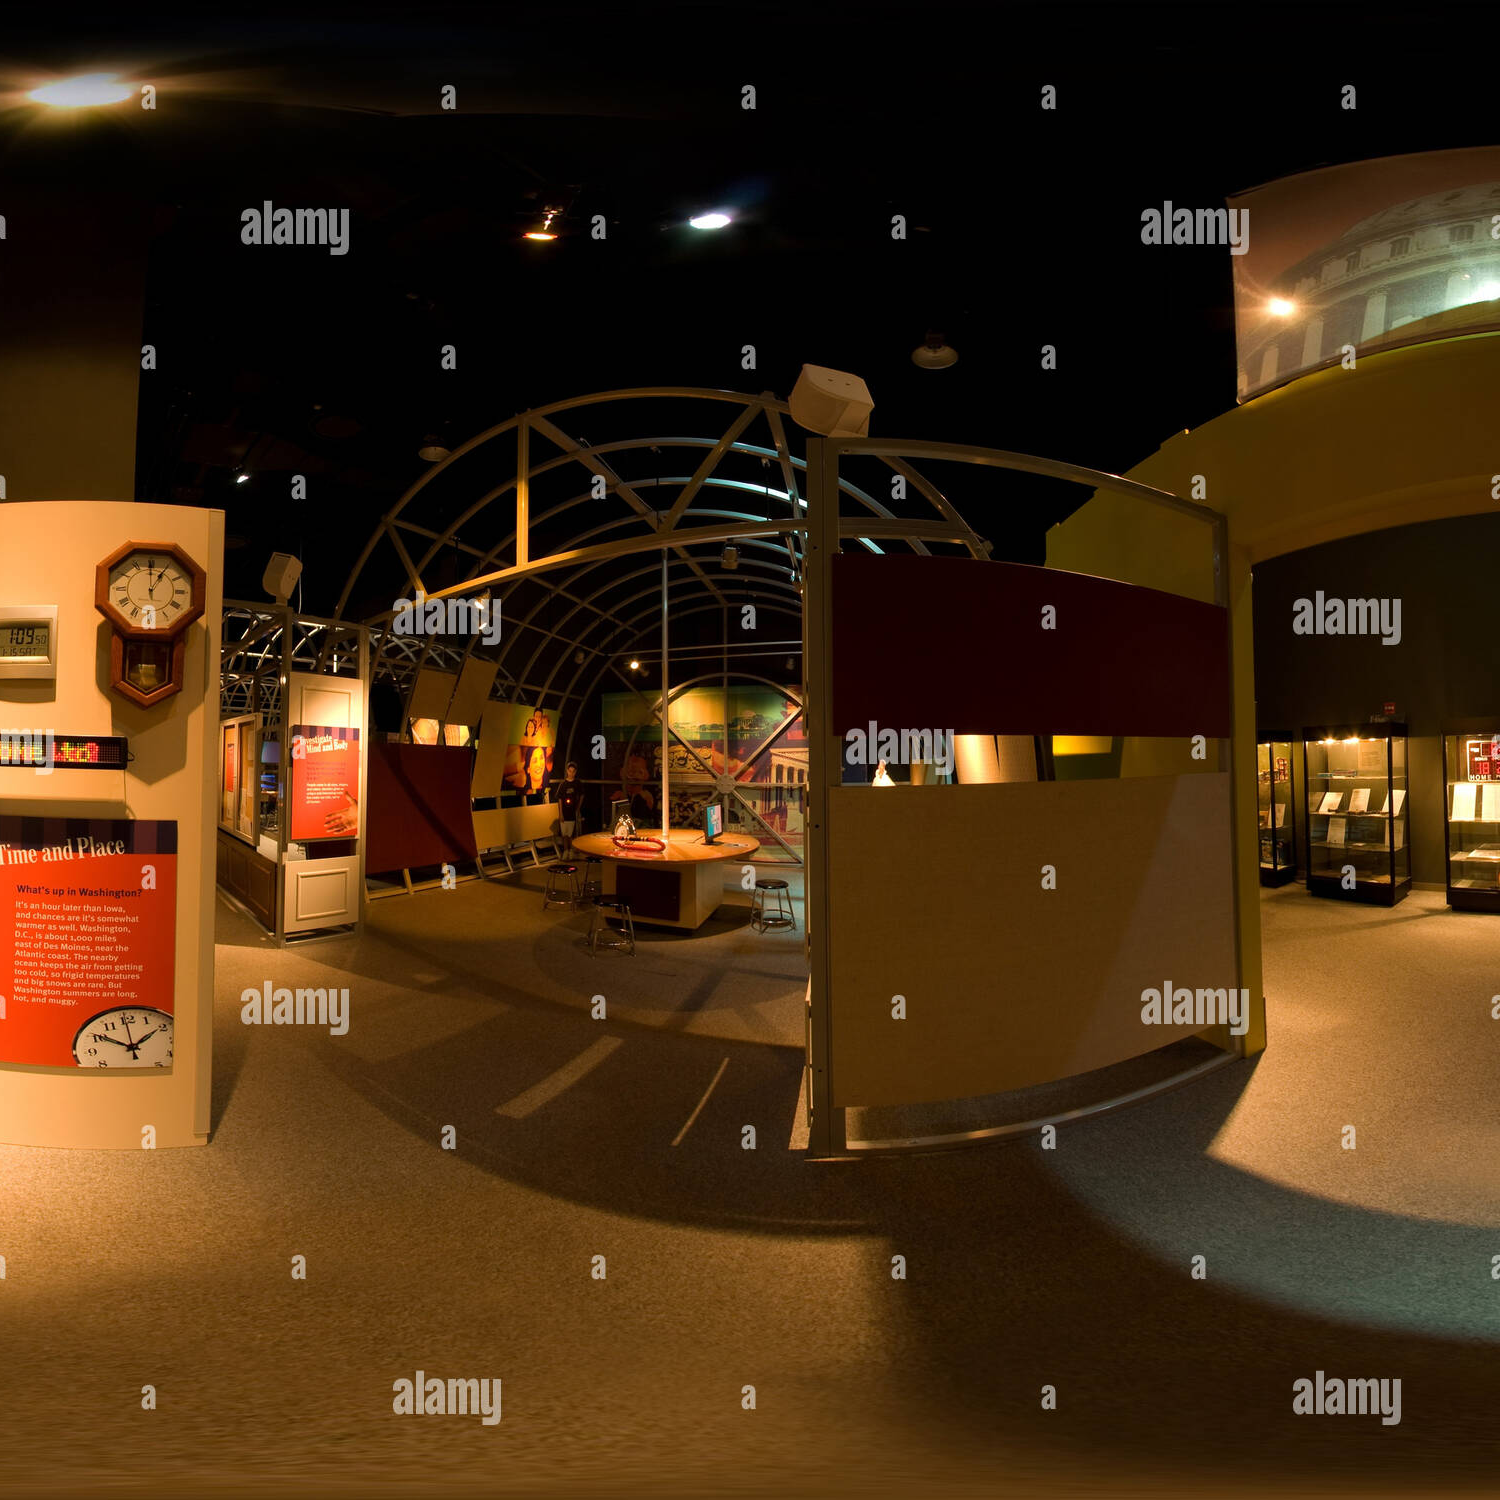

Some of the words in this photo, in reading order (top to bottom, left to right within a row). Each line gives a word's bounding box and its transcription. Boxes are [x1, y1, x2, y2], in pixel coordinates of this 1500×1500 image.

[10, 627, 34, 644] 1:09
[307, 744, 321, 752] Mind
[334, 739, 348, 751] Body
[42, 839, 74, 862] and
[76, 836, 125, 859] Place
[17, 885, 50, 895] What's
[53, 888, 64, 897] up
[68, 887, 76, 896] in
[79, 888, 142, 898] Washington?
[42, 902, 60, 910] hour
[63, 903, 81, 911] later
[83, 904, 101, 912] than
[104, 904, 126, 914] Iowa,
[33, 912, 65, 921] chances
[16, 922, 45, 930] warmer
[59, 923, 77, 931] well.
[80, 924, 130, 933] Washington,
[15, 931, 33, 939] D.C.,
[45, 932, 68, 940] about
[95, 934, 116, 942] miles
[61, 943, 92, 952] Moines,
[15, 950, 44, 958] Atlantic
[48, 952, 71, 960] coast.
[91, 954, 118, 962] nearby
[40, 960, 63, 969] keeps
[30, 969, 48, 977] cold,
[62, 971, 84, 979] frigid
[86, 972, 140, 980] temperatures
[31, 978, 44, 986] big
[14, 986, 60, 996] Washington
[120, 1015, 136, 1025] 12
[143, 1016, 149, 1024] 1
[104, 1022, 116, 1031] 11
[159, 1024, 168, 1032] 2
[88, 1048, 97, 1056] 9
